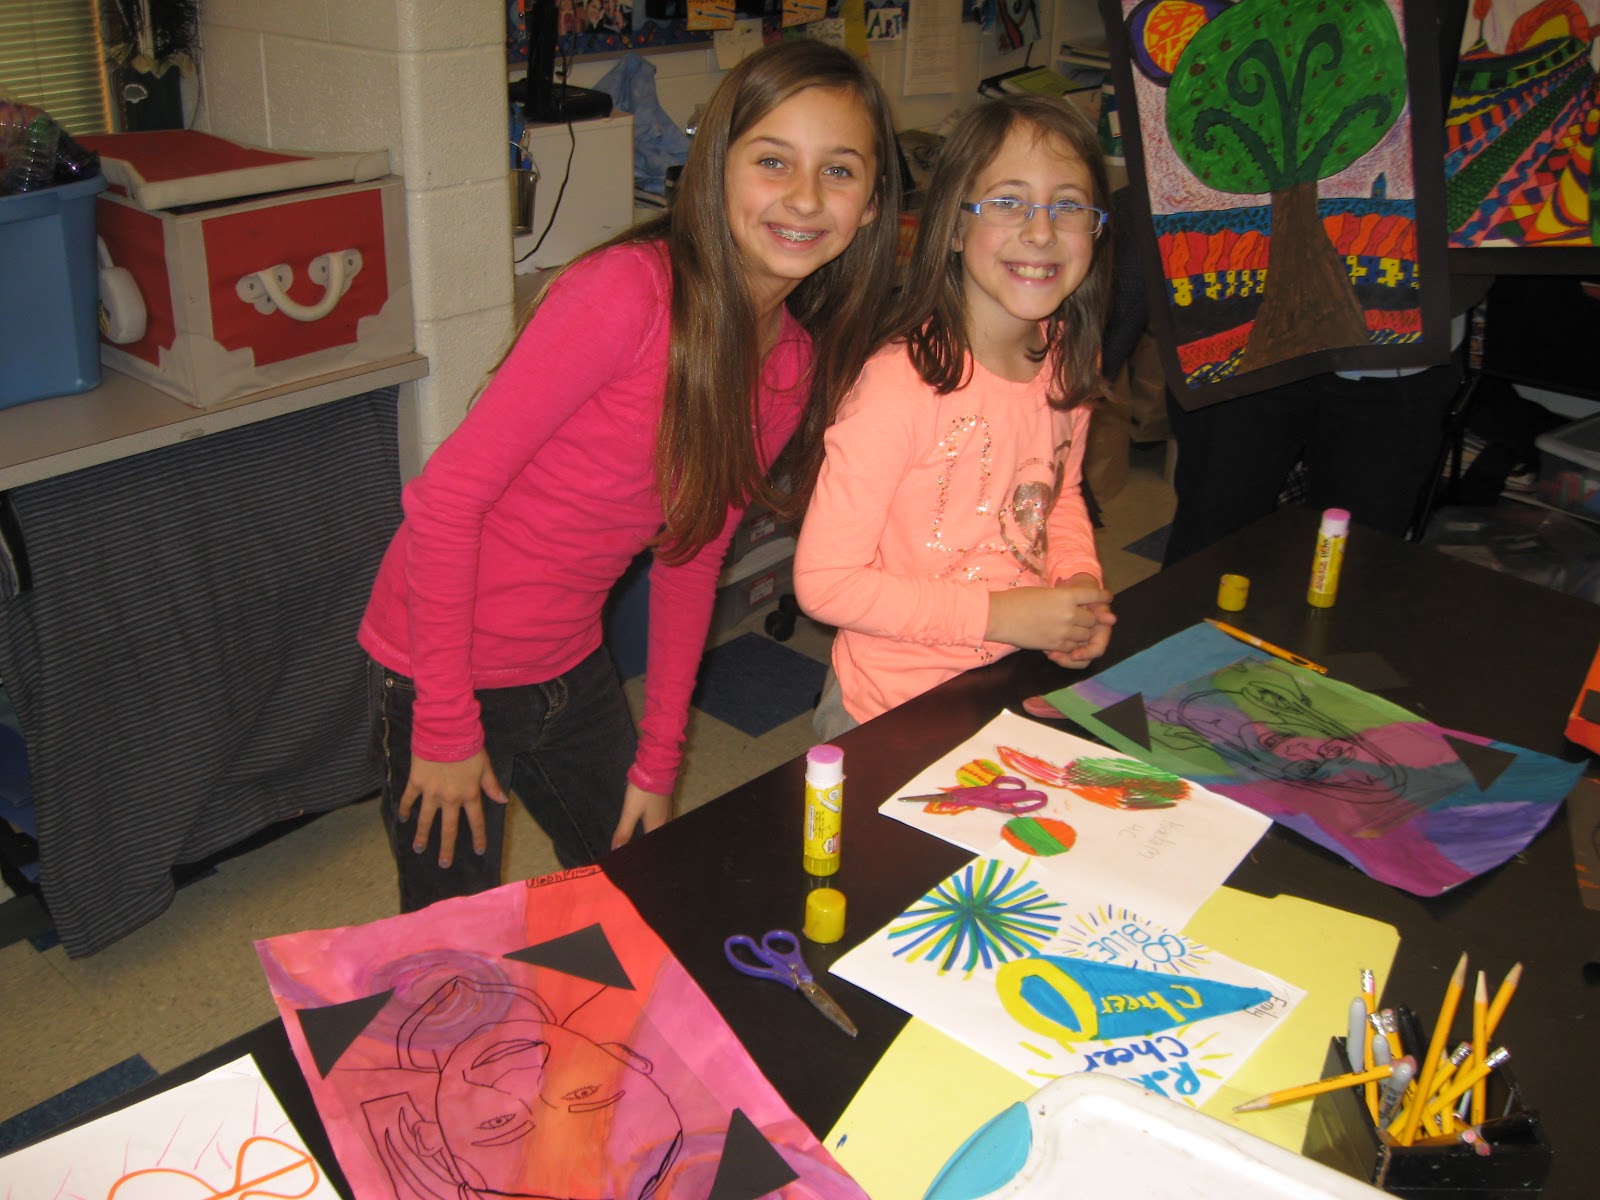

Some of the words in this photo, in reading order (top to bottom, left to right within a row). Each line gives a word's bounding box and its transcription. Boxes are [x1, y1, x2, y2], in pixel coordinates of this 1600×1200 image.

[866, 12, 902, 39] ART
[1087, 923, 1151, 963] BLUE
[1142, 934, 1186, 964] GO
[1101, 984, 1204, 1023] Cheer
[1243, 995, 1287, 1020] Emily
[1083, 1036, 1189, 1072] Cheer
